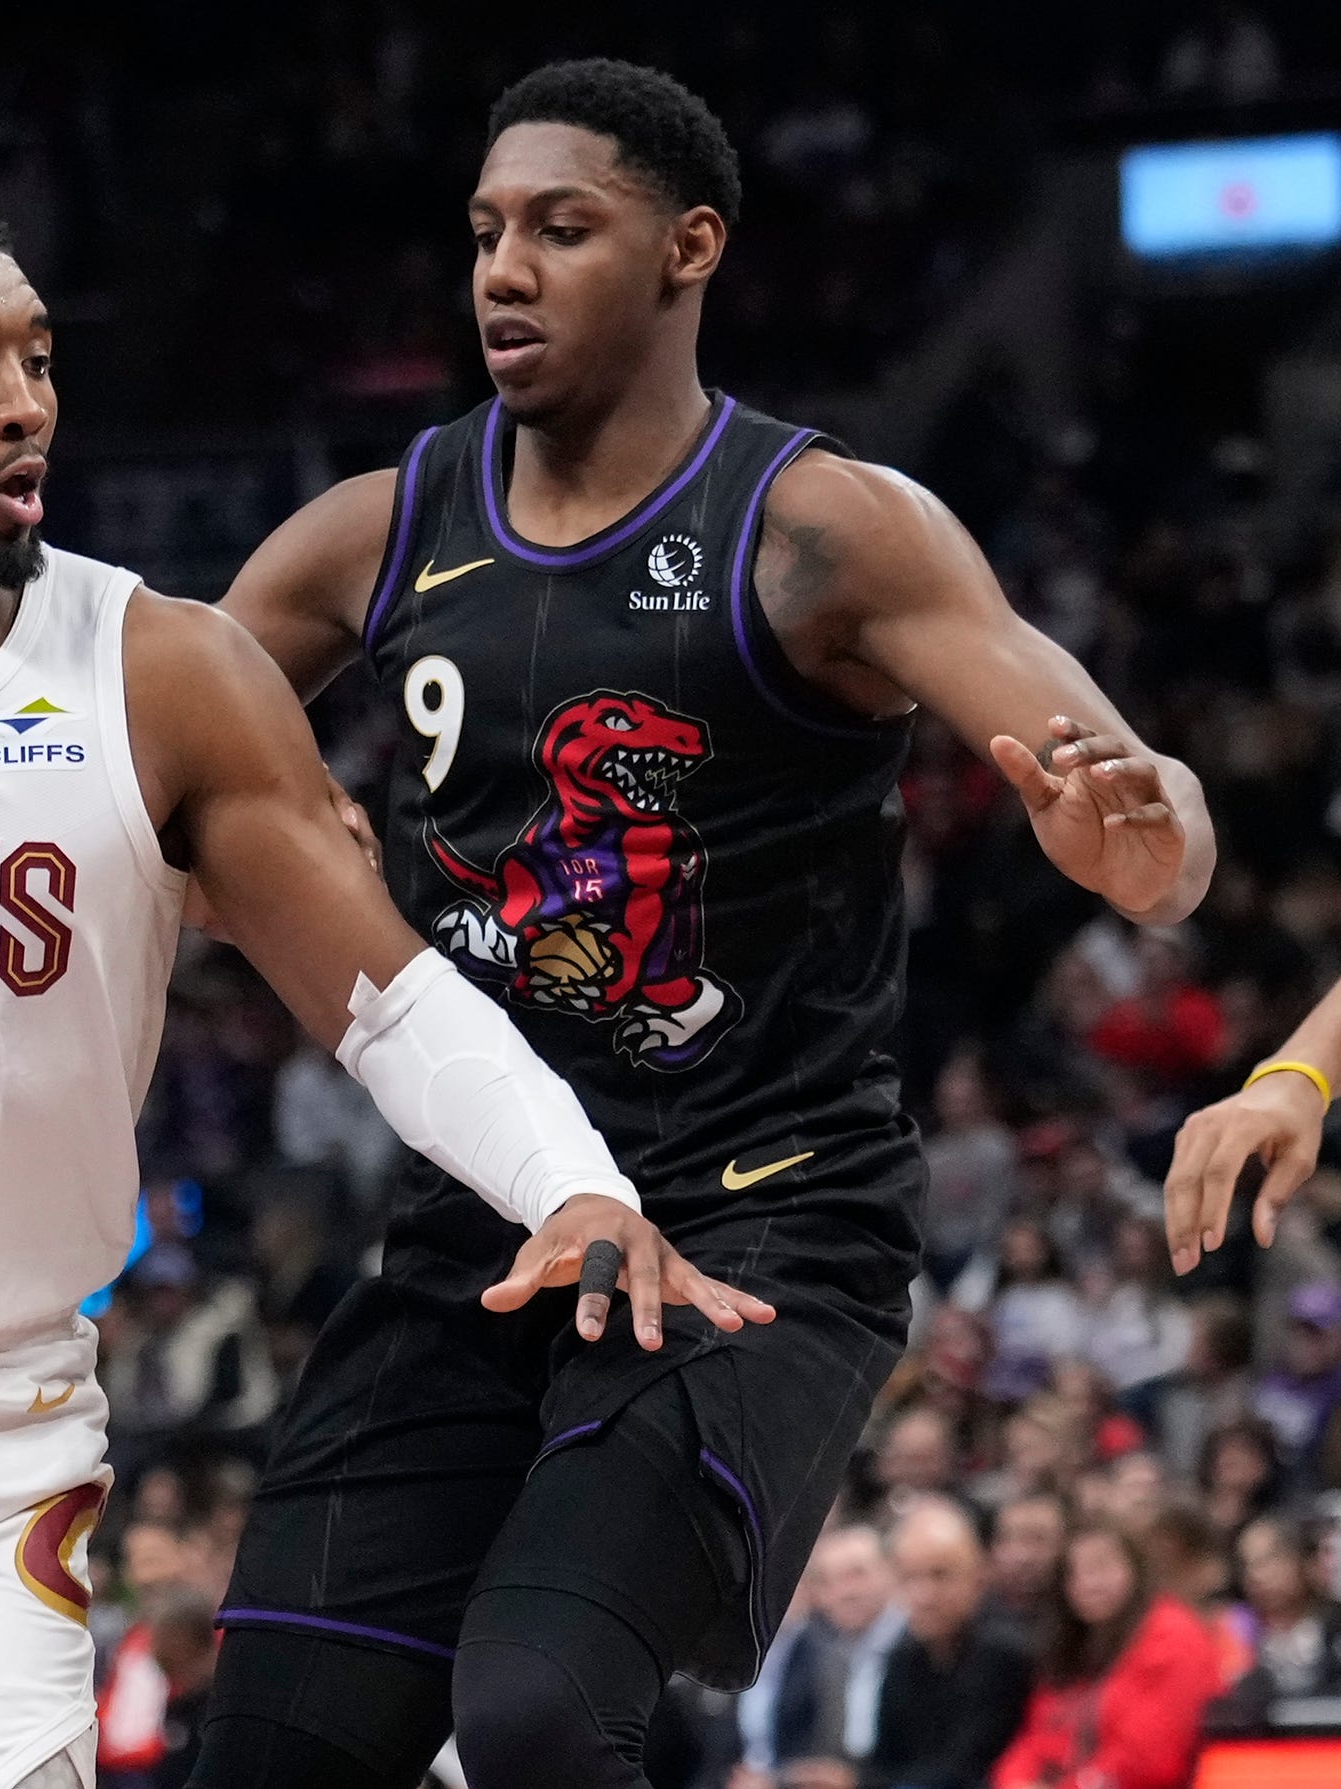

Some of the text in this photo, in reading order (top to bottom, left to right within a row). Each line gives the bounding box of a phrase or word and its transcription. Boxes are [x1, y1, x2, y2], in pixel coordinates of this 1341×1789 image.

[629, 591, 710, 611] Sun Life
[404, 655, 465, 794] 9
[574, 879, 603, 903] 15
